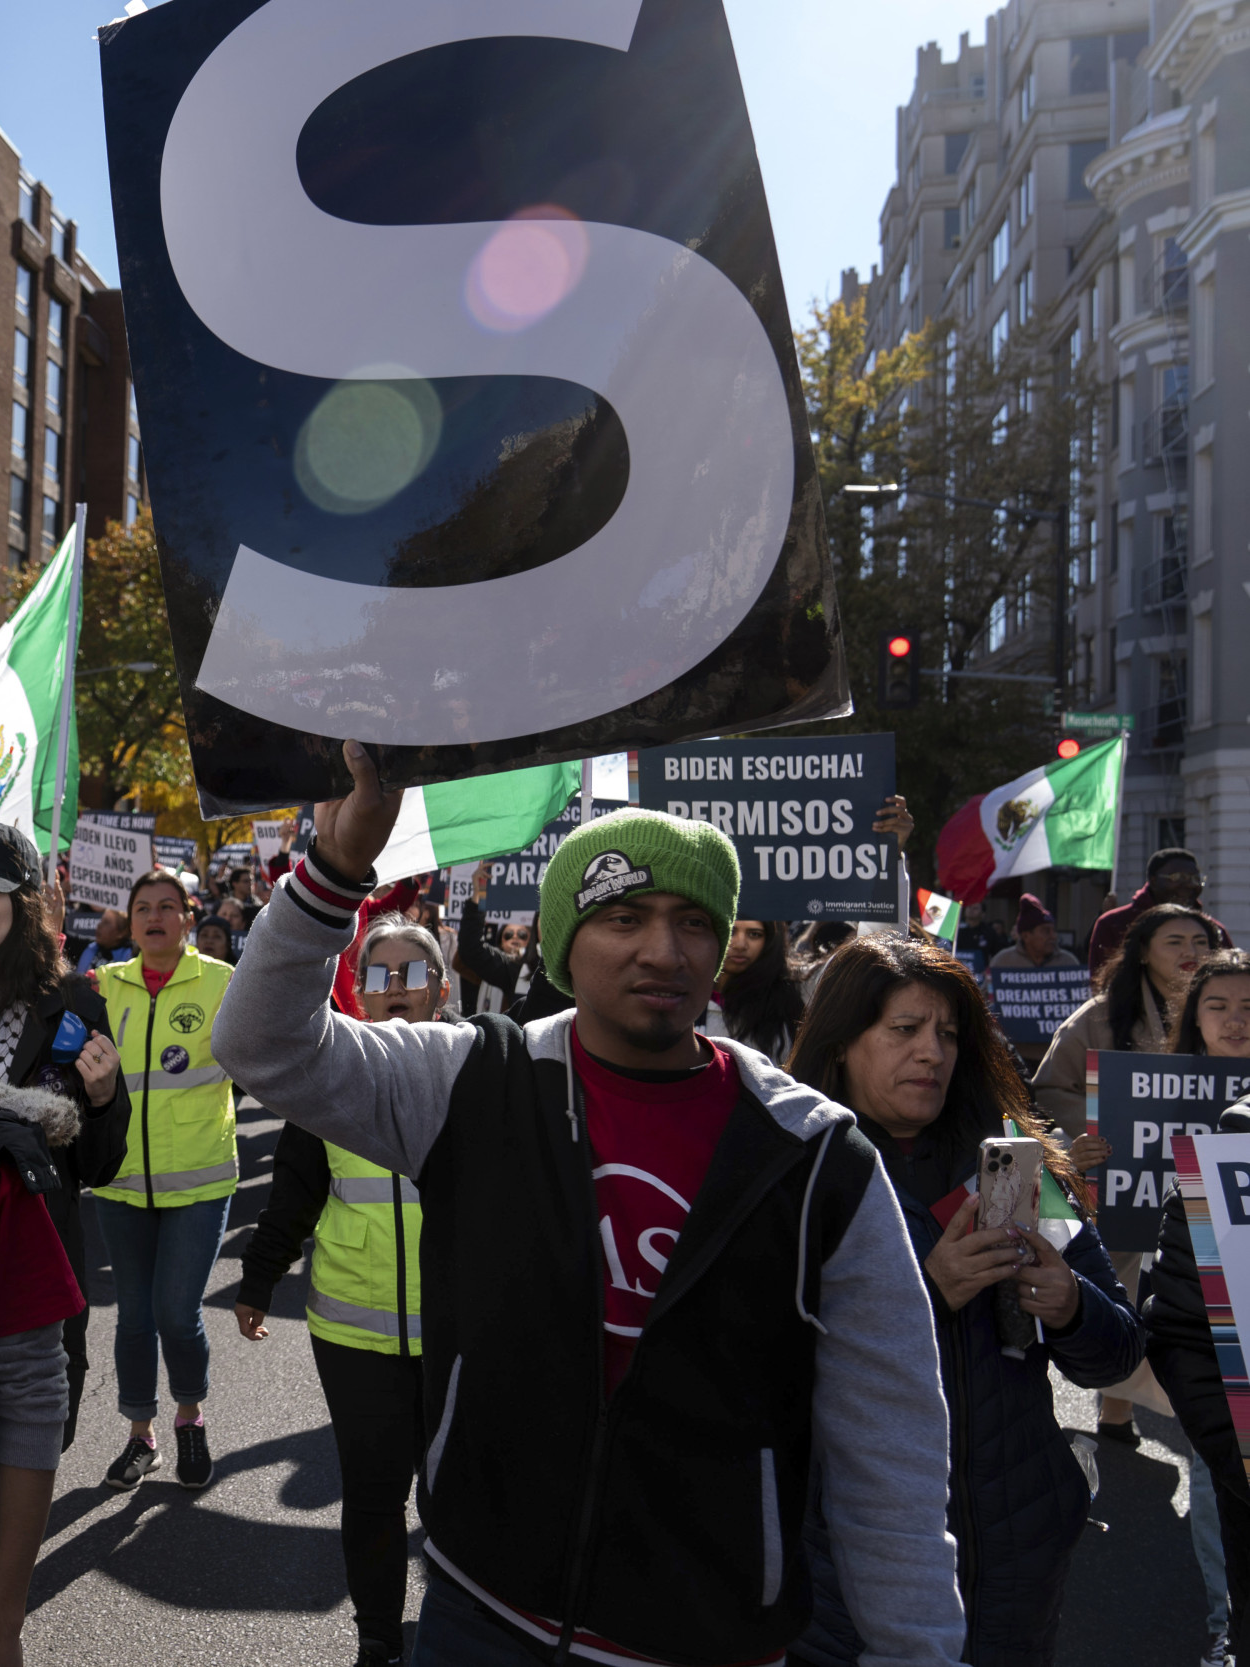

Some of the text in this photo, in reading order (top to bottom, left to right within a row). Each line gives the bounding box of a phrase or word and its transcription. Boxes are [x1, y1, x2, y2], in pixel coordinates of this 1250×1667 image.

[160, 0, 795, 746] S
[665, 753, 863, 780] BIDEN ESCUCHA!
[104, 832, 137, 854] LLEVO
[104, 852, 134, 873] AÑOS
[754, 844, 888, 880] TODOS!
[72, 865, 133, 891] ESPERANDO
[610, 870, 647, 891] WORLD
[72, 883, 118, 906] PERMISO
[825, 900, 895, 910] Immigrant Justice
[1001, 972, 1055, 983] PRESIDENT
[996, 988, 1068, 1003] DREAMERS
[1002, 1004, 1041, 1018] WORK
[163, 1050, 187, 1072] SWOP
[1132, 1072, 1214, 1100] BIDEN
